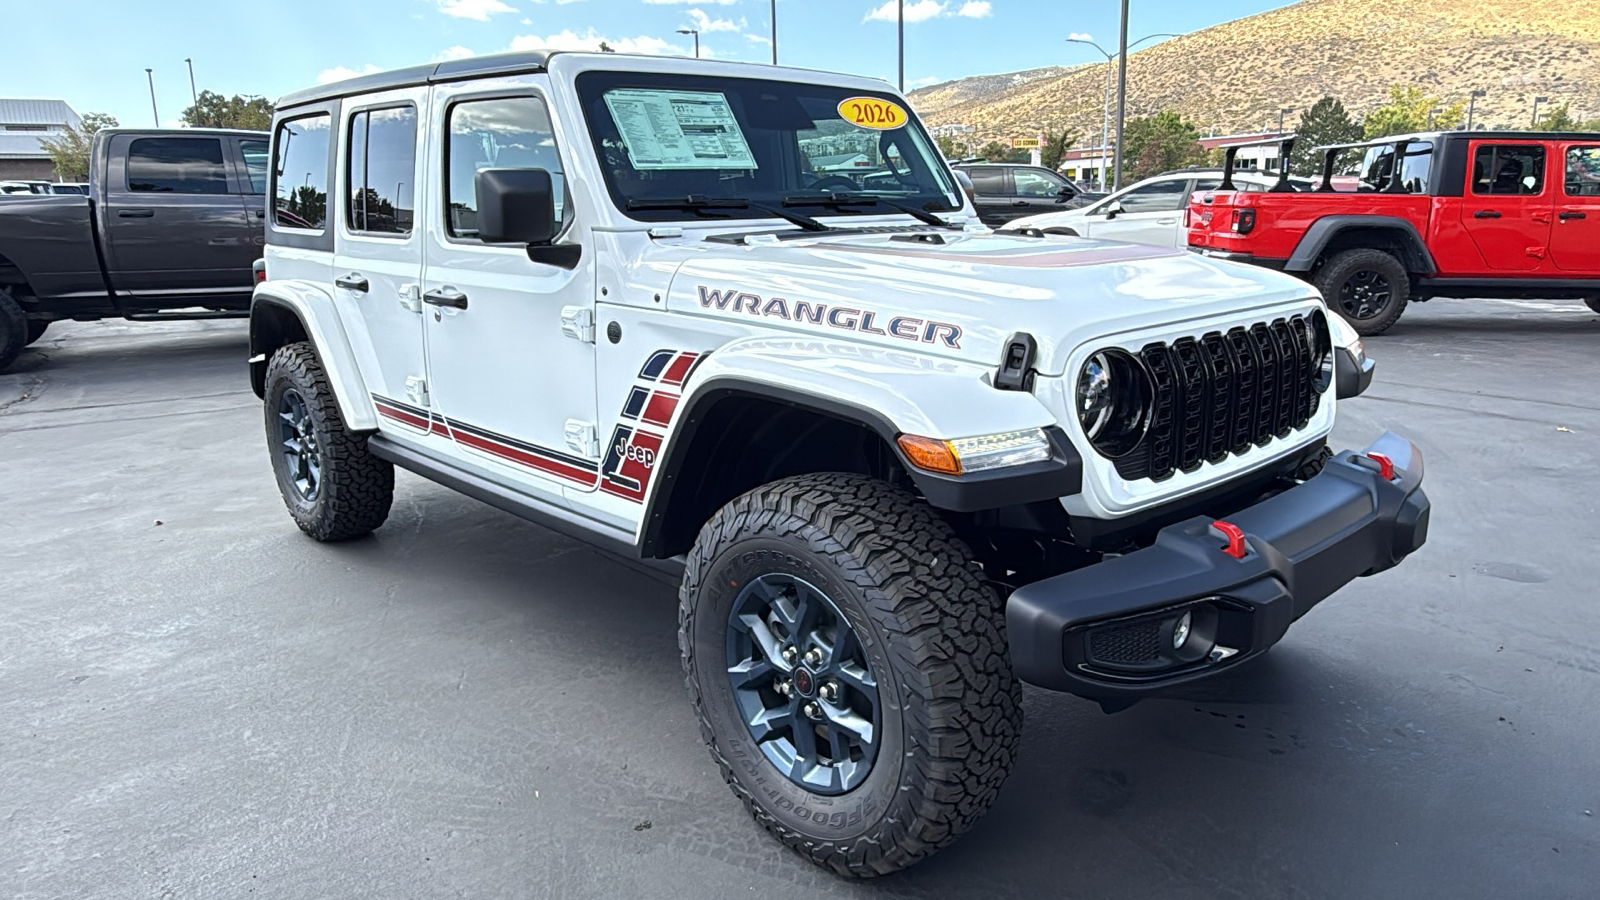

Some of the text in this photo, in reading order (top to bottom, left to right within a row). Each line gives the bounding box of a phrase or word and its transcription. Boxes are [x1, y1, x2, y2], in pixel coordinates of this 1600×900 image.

[852, 104, 896, 123] 2026
[697, 286, 962, 349] WRANGLER
[615, 437, 656, 469] Jeep
